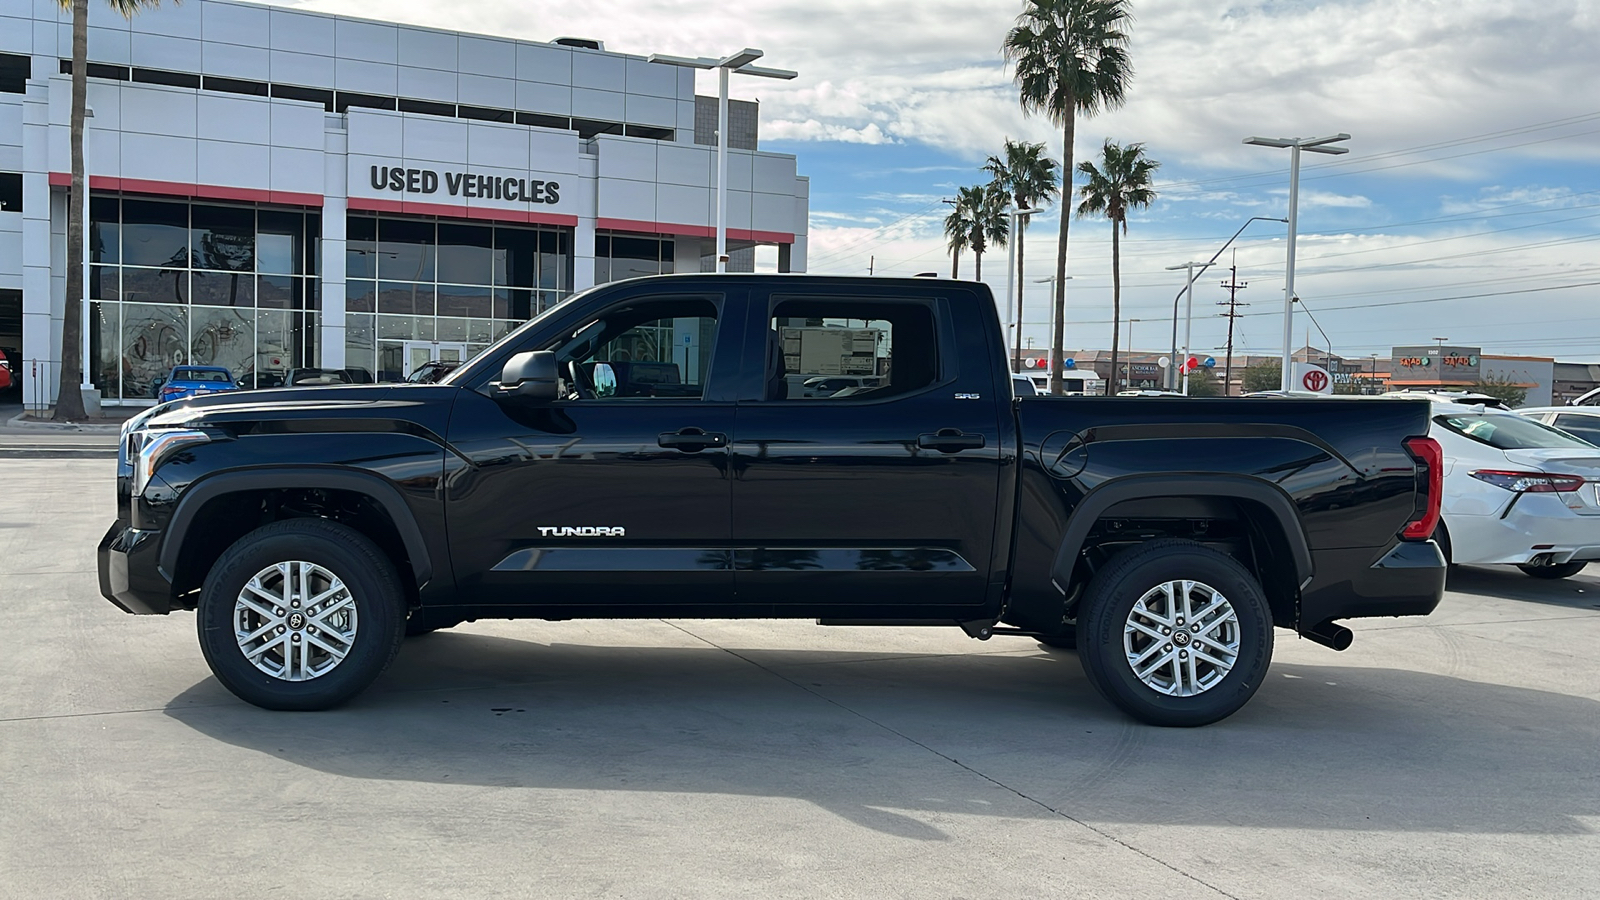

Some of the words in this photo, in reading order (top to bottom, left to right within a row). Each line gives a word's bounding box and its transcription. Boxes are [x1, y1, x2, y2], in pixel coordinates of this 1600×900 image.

[371, 165, 438, 194] USED
[445, 172, 560, 204] VEHICLES
[536, 526, 626, 537] TUNDRA
